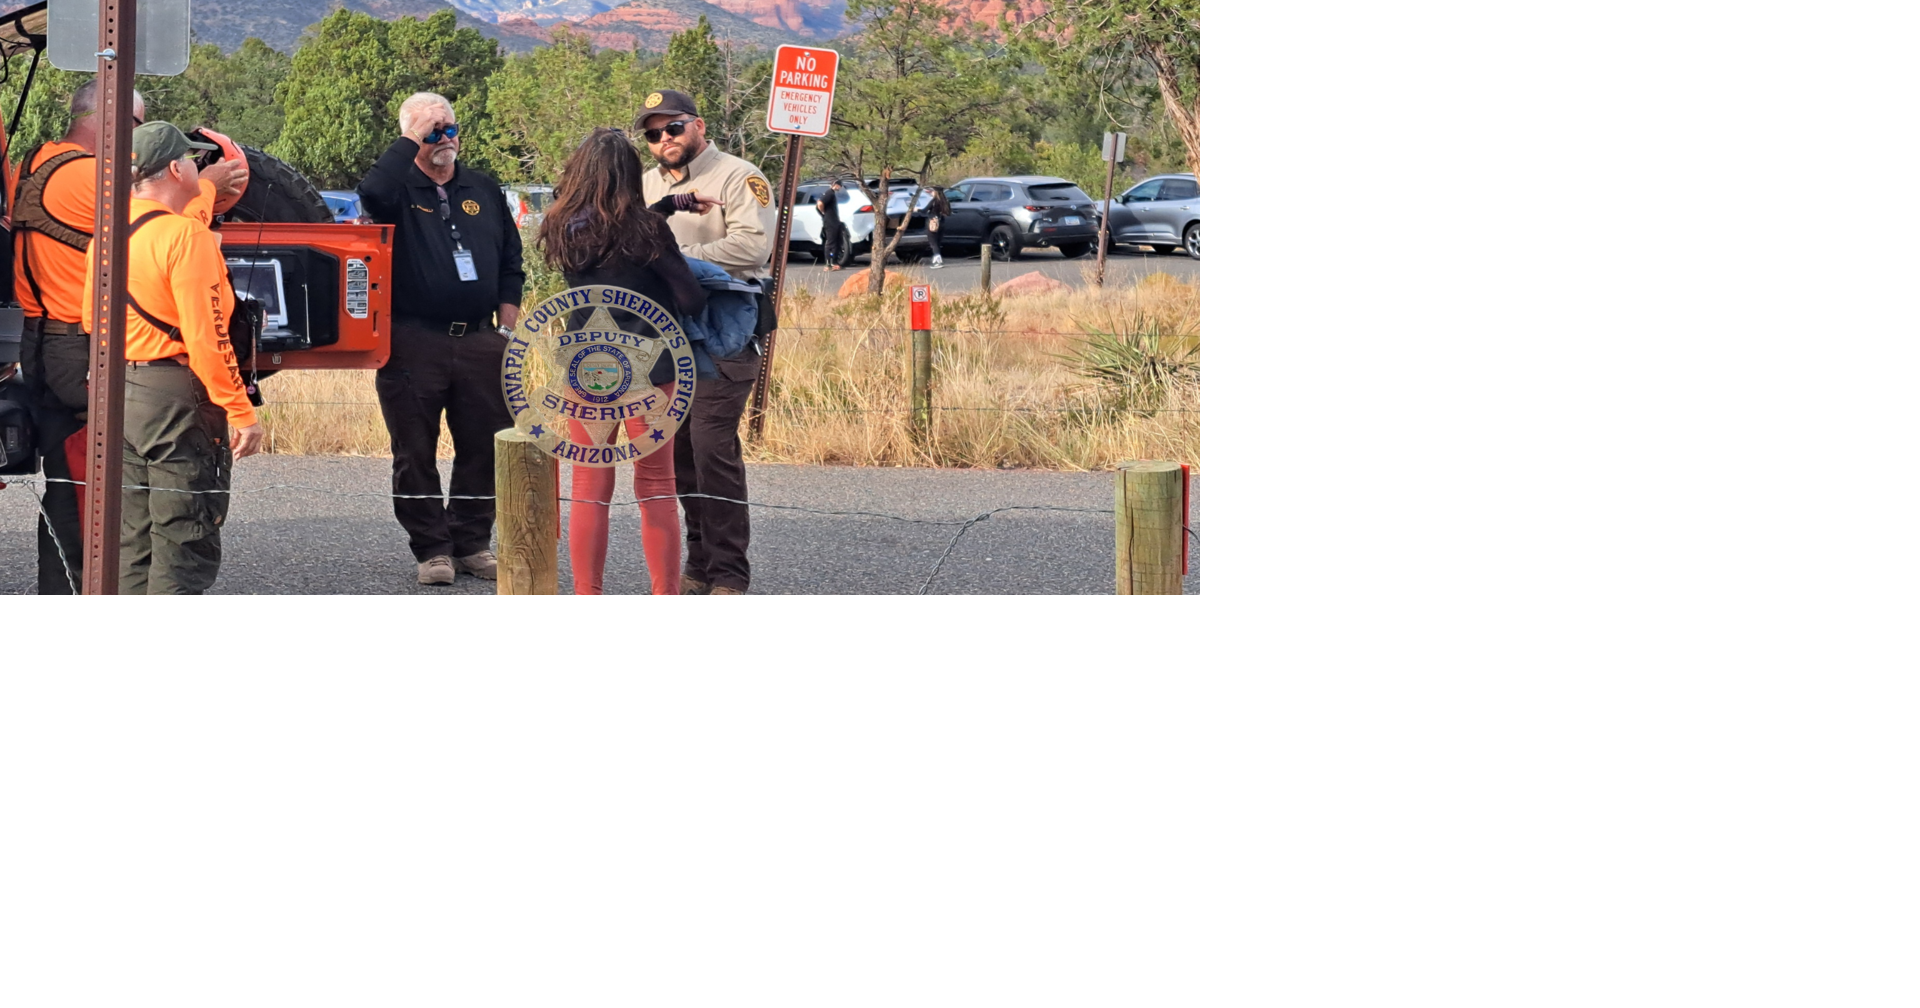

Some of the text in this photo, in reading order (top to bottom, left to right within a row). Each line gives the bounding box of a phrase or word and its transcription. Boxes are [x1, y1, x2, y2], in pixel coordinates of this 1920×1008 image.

[796, 56, 817, 72] NO
[779, 70, 829, 89] PARKING
[780, 90, 823, 104] EMERGENCY
[783, 102, 818, 115] VEHICLES
[788, 114, 809, 125] ONLY
